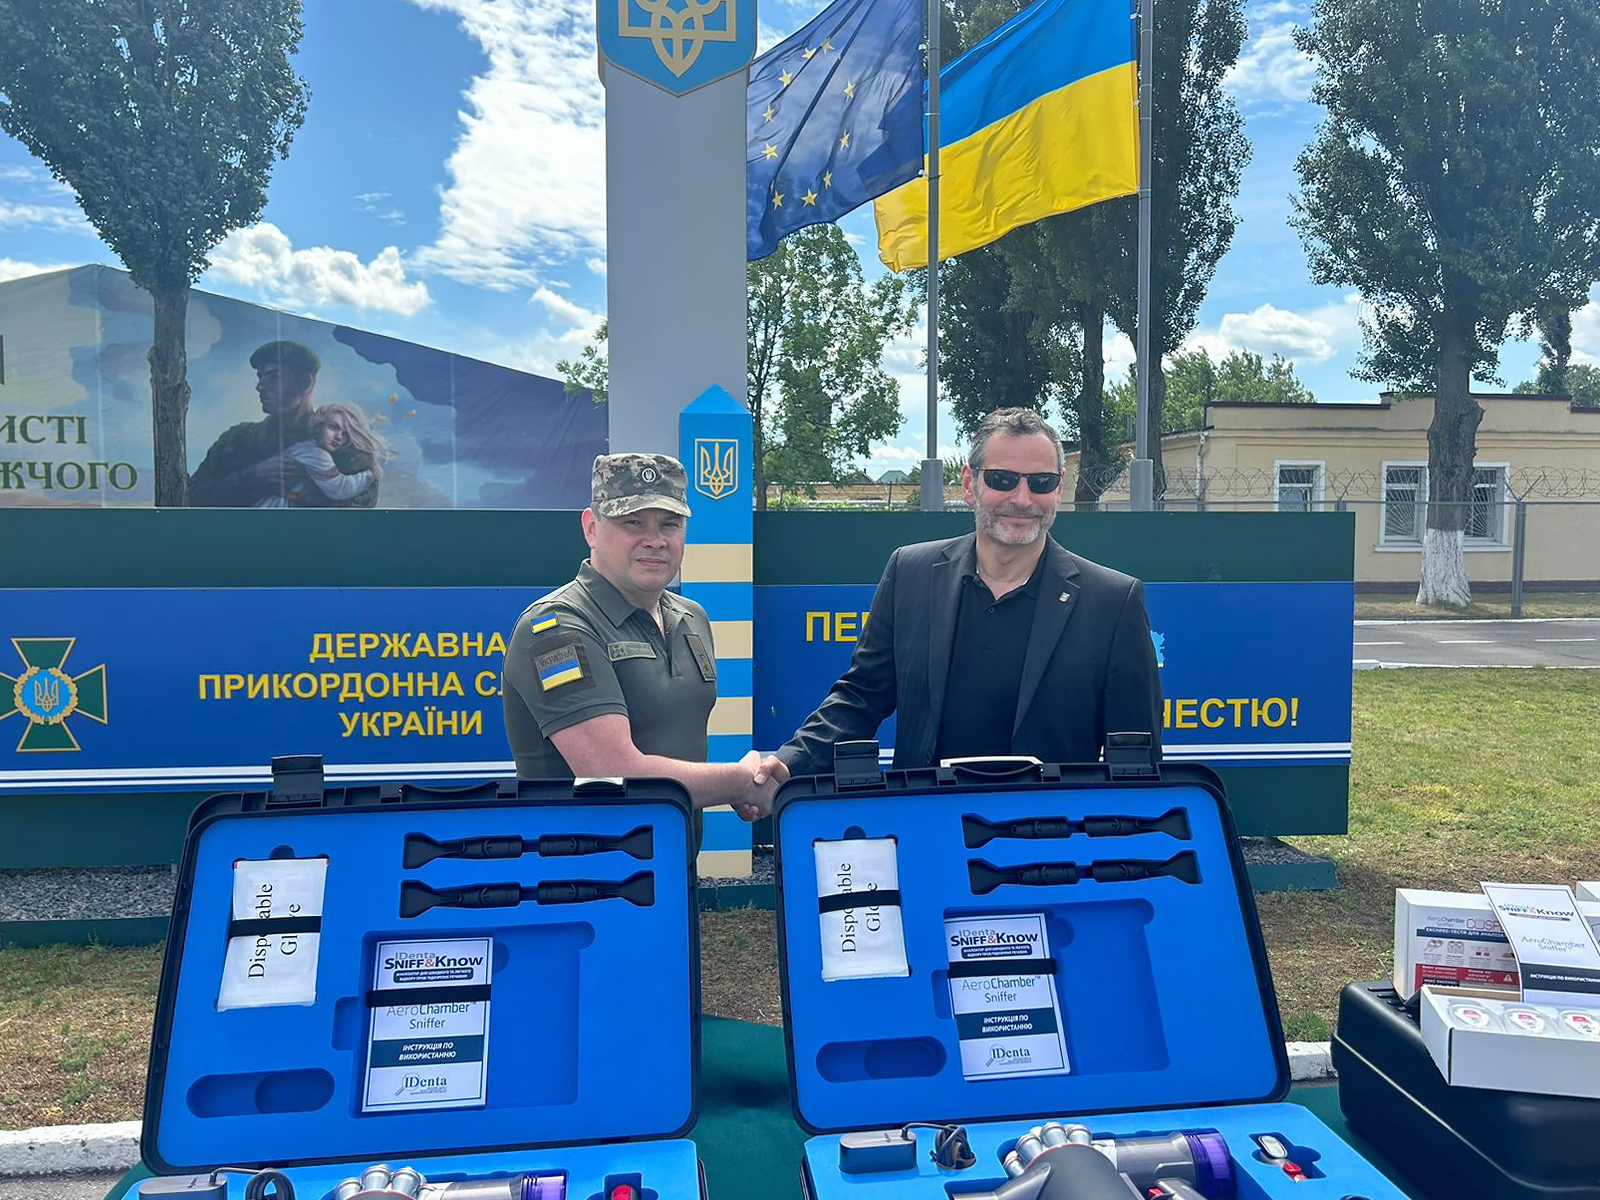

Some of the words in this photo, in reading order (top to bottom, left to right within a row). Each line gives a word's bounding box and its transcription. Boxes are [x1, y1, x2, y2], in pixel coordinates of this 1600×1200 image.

[806, 611, 870, 642] ПЕ
[309, 632, 506, 663] ДЕРЖАВНА
[199, 671, 465, 703] ПРИКОРДОННА
[474, 671, 504, 697] С
[339, 706, 482, 738] УКРАЇНИ
[248, 883, 273, 979] Dispable
[280, 903, 301, 956] Gle
[984, 991, 1017, 1004] Sniffer
[409, 1018, 445, 1030] Sniffer
[398, 1051, 457, 1060] ВИКОРИСТАННЮ
[402, 1042, 443, 1051] ІНСТРУКЦІЯ
[992, 1047, 1030, 1059] IDenta
[405, 1076, 447, 1088] IDenta
